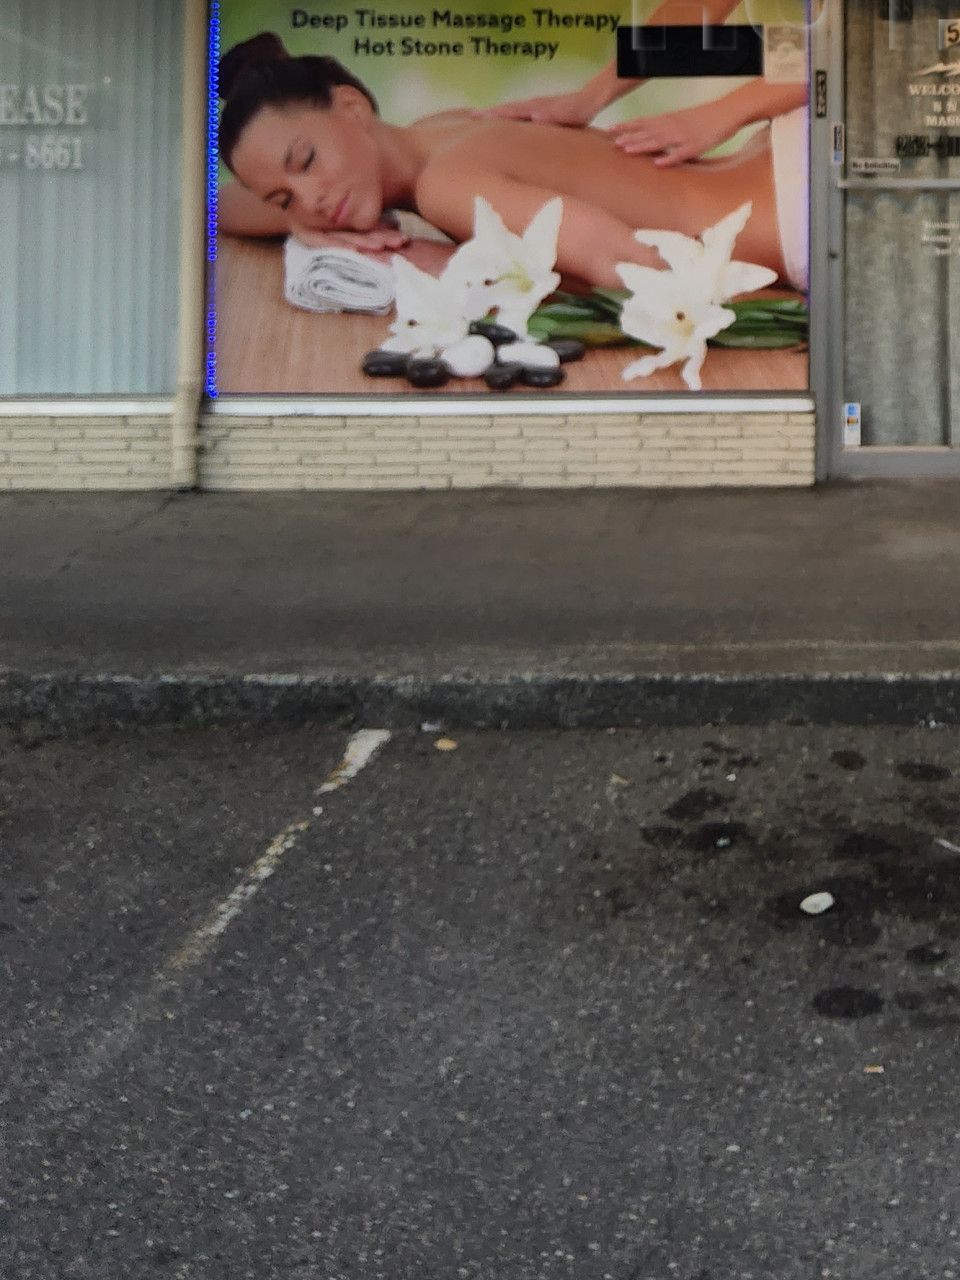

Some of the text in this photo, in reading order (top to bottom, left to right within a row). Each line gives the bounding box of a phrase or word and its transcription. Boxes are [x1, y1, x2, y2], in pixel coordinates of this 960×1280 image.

[292, 9, 621, 32] Deep Tissue Massage Therapy
[354, 36, 559, 60] Hot Stone Therapy
